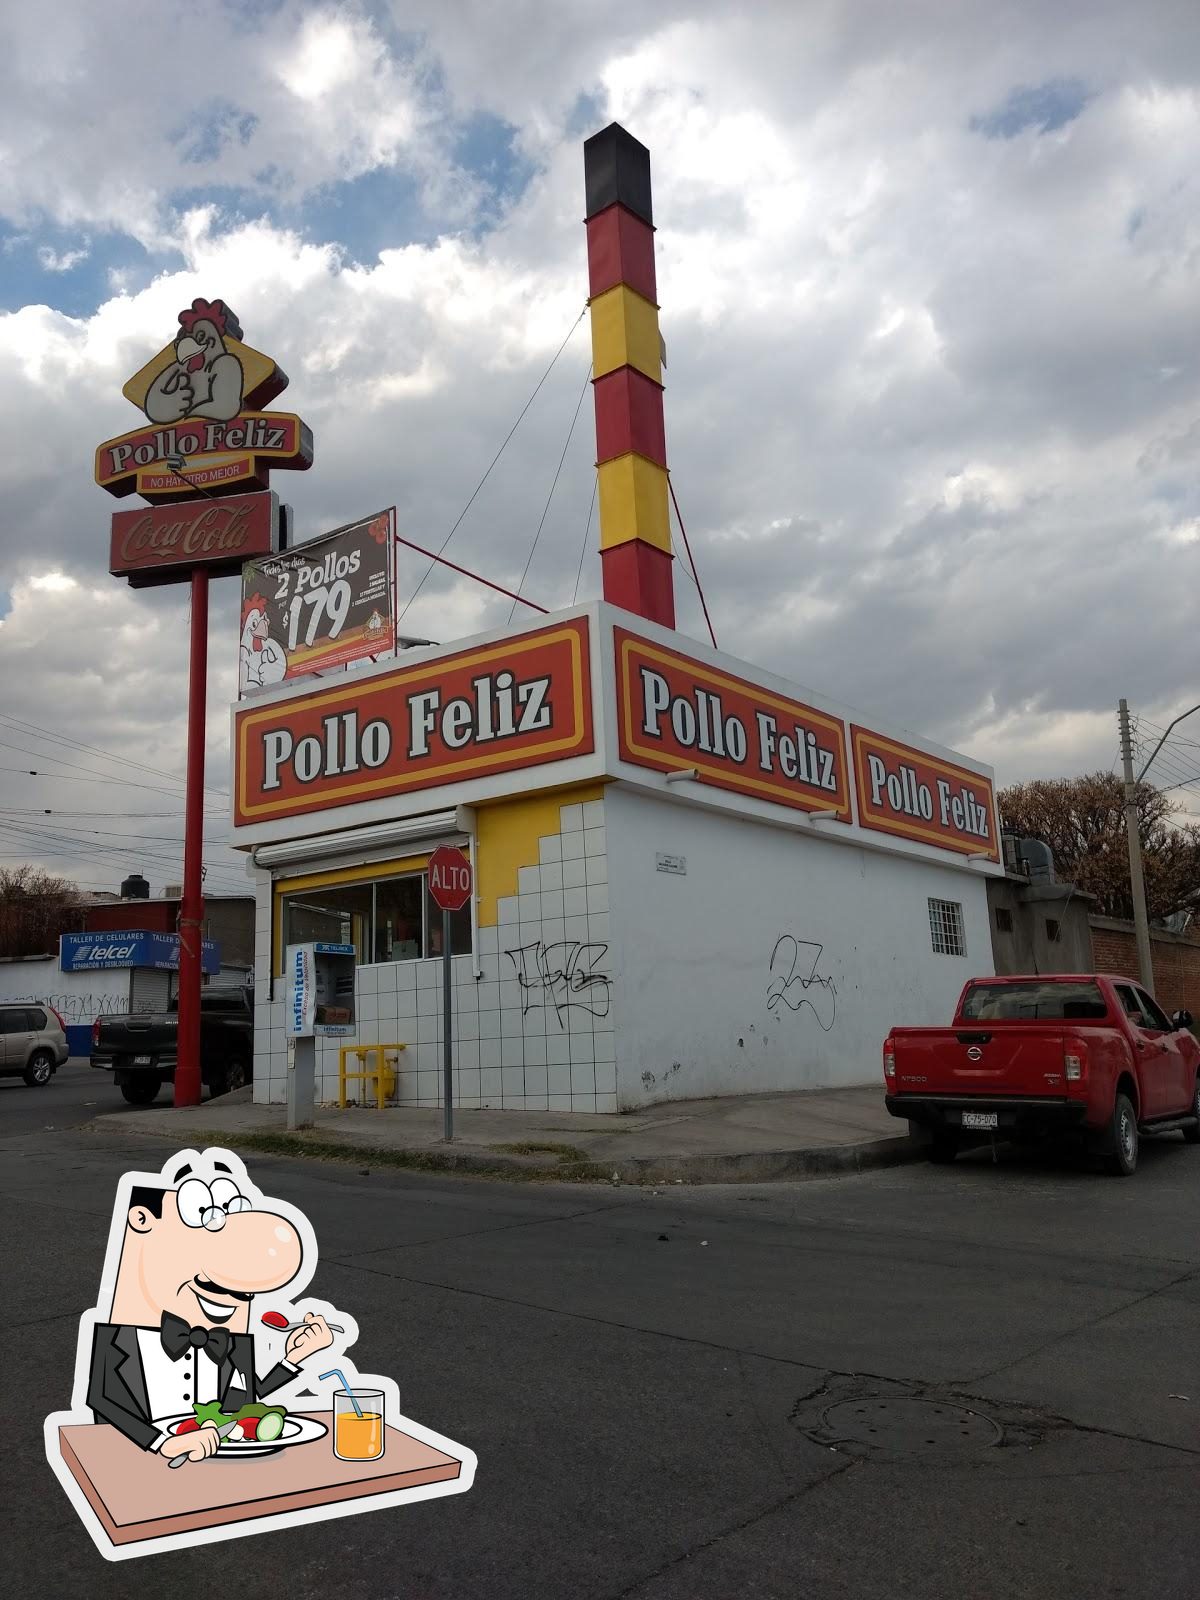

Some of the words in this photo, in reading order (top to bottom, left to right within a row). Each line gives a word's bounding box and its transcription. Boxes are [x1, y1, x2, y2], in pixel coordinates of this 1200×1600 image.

[109, 428, 199, 474] Pollo
[203, 419, 287, 451] Feliz
[150, 477, 164, 488] NO
[165, 476, 182, 487] HAY
[184, 472, 208, 485] OTRO
[210, 465, 240, 480] MEJOR
[121, 503, 258, 561] Coca-Cola
[274, 572, 290, 600] 2
[295, 550, 361, 594] Pollos
[261, 708, 392, 791] Pollo
[407, 669, 552, 759] Feliz
[639, 666, 747, 763] Pollo
[755, 710, 838, 793] Feliz
[867, 752, 934, 821] Pollo
[936, 778, 990, 838] Feliz
[431, 864, 470, 891] ALTO
[69, 936, 93, 944] TALLER
[106, 932, 144, 941] CELULARES
[88, 943, 137, 960] telcel
[152, 933, 174, 943] TALLER
[294, 951, 304, 1031] infinitum
